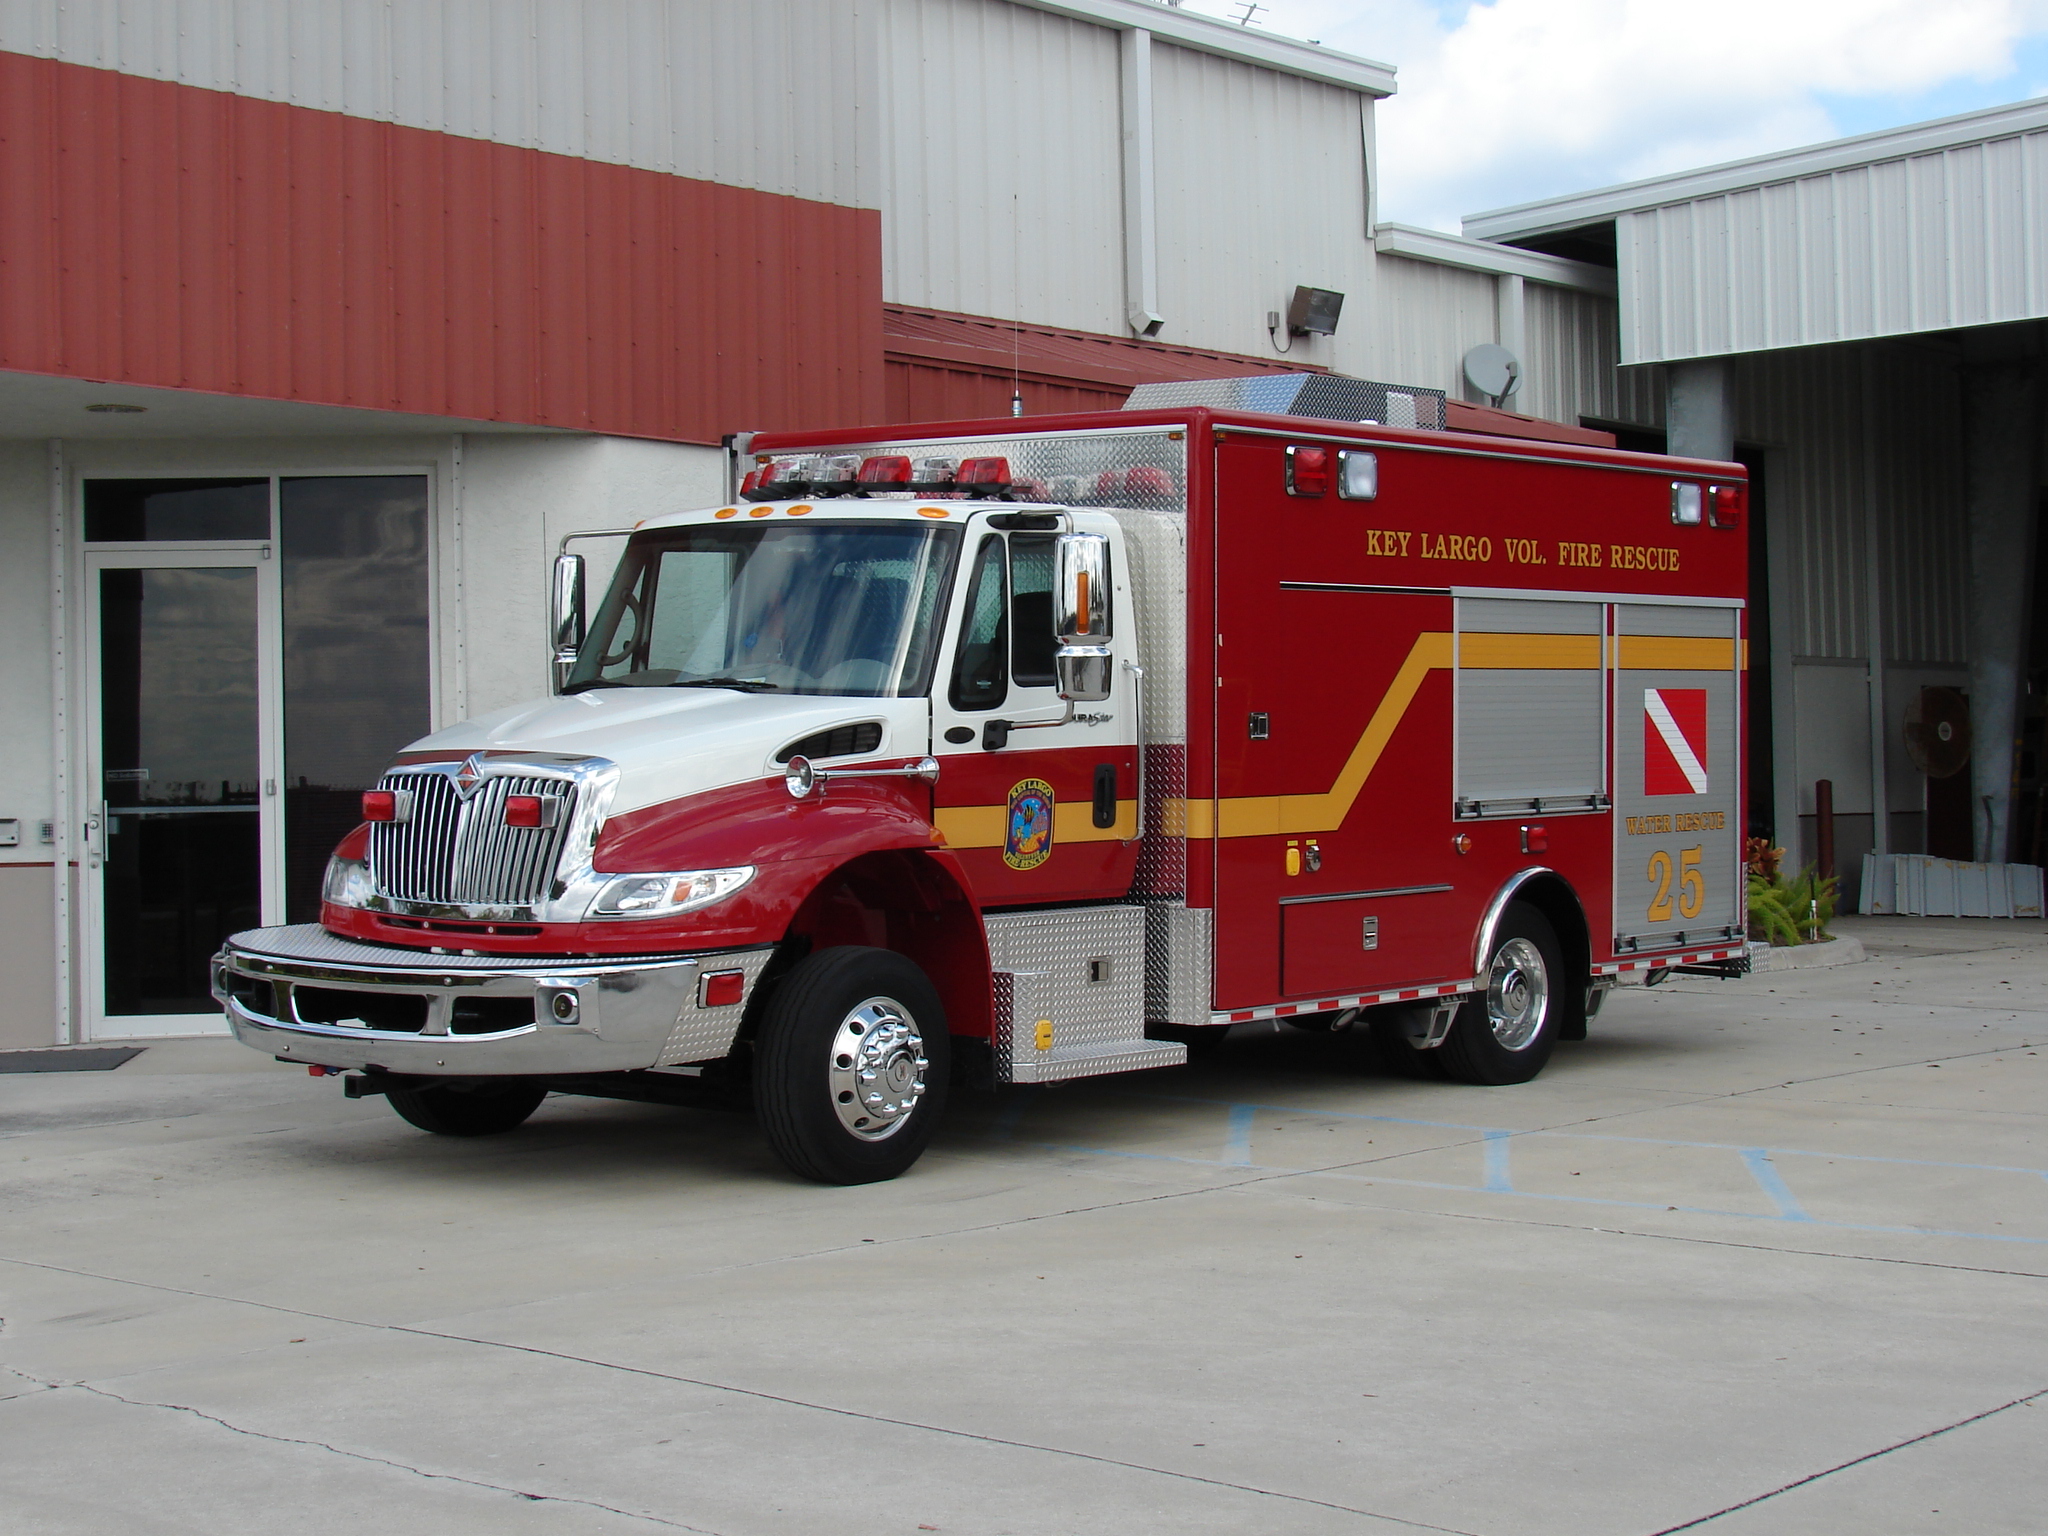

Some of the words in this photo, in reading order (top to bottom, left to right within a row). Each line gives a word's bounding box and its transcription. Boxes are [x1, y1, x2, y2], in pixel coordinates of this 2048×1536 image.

[1366, 529, 1411, 557] KEY
[1421, 533, 1492, 562] LARGO
[1504, 538, 1547, 565] VOL.
[1558, 541, 1602, 568] FIRE
[1610, 545, 1680, 572] RESCUE
[1625, 814, 1672, 836] WATER
[1675, 811, 1725, 833] RESCUE
[1647, 843, 1705, 923] 25
